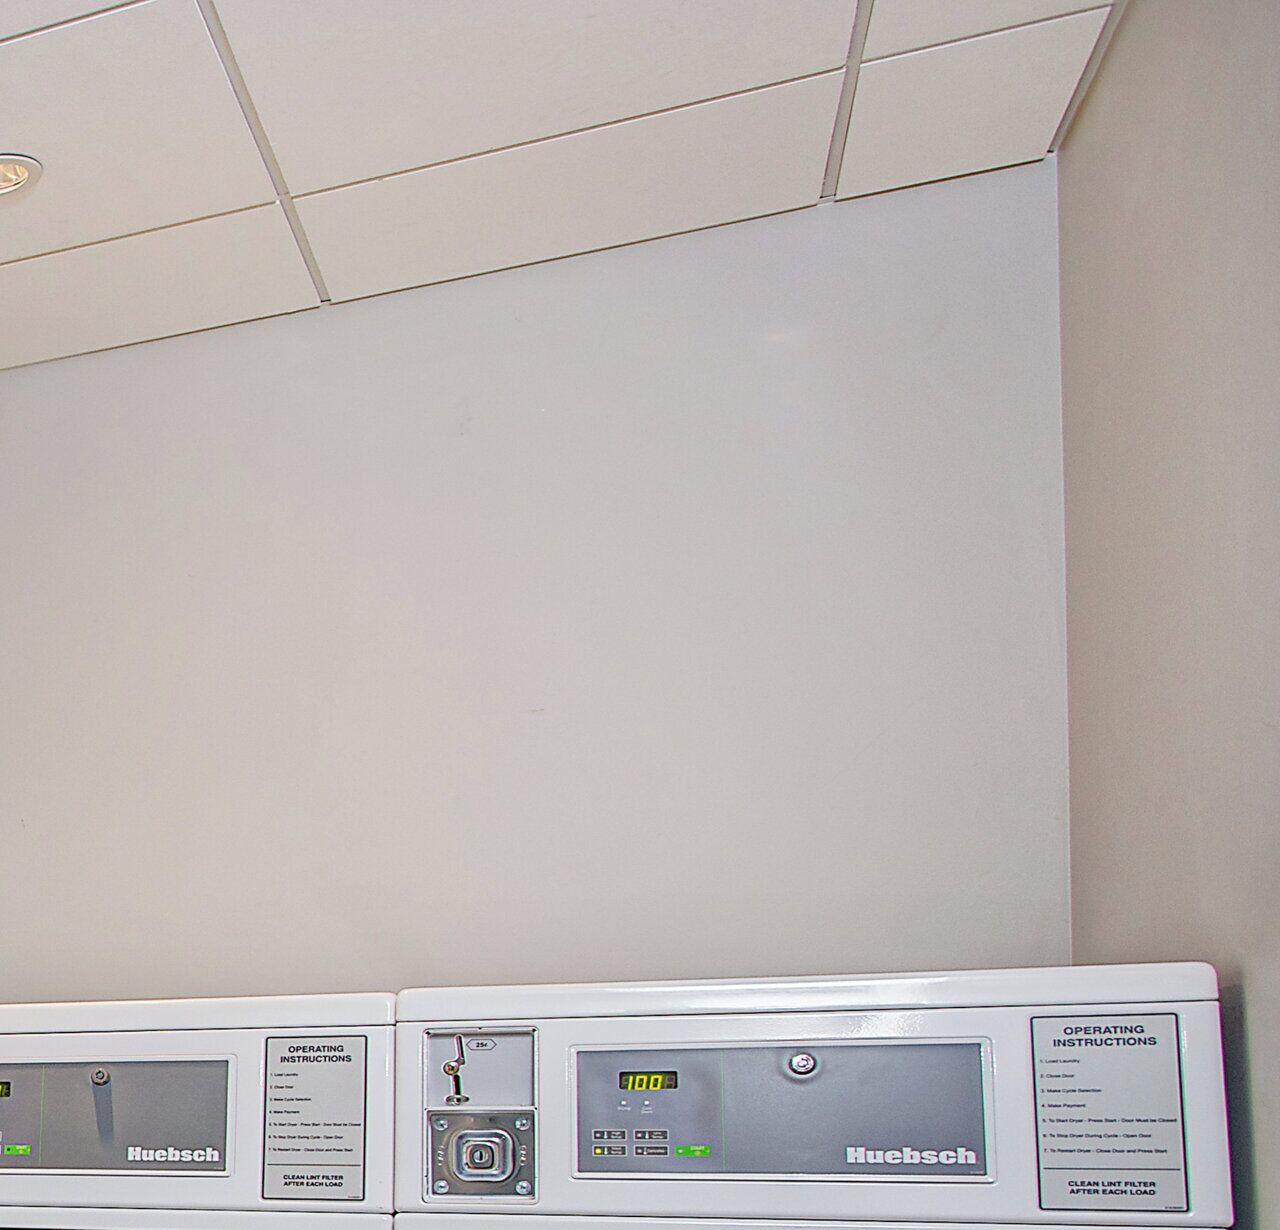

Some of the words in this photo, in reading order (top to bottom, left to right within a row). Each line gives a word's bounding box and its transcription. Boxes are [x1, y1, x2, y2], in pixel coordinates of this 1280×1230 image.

[1063, 1025, 1145, 1035] OPERATING
[1053, 1037, 1157, 1047] INSTRUCTIONS
[288, 1045, 344, 1053] OPERATING
[280, 1055, 352, 1063] INSTRUCTIONS
[628, 1075, 662, 1091] 100
[127, 1146, 220, 1162] Huebsch
[846, 1147, 977, 1165] Huebsch
